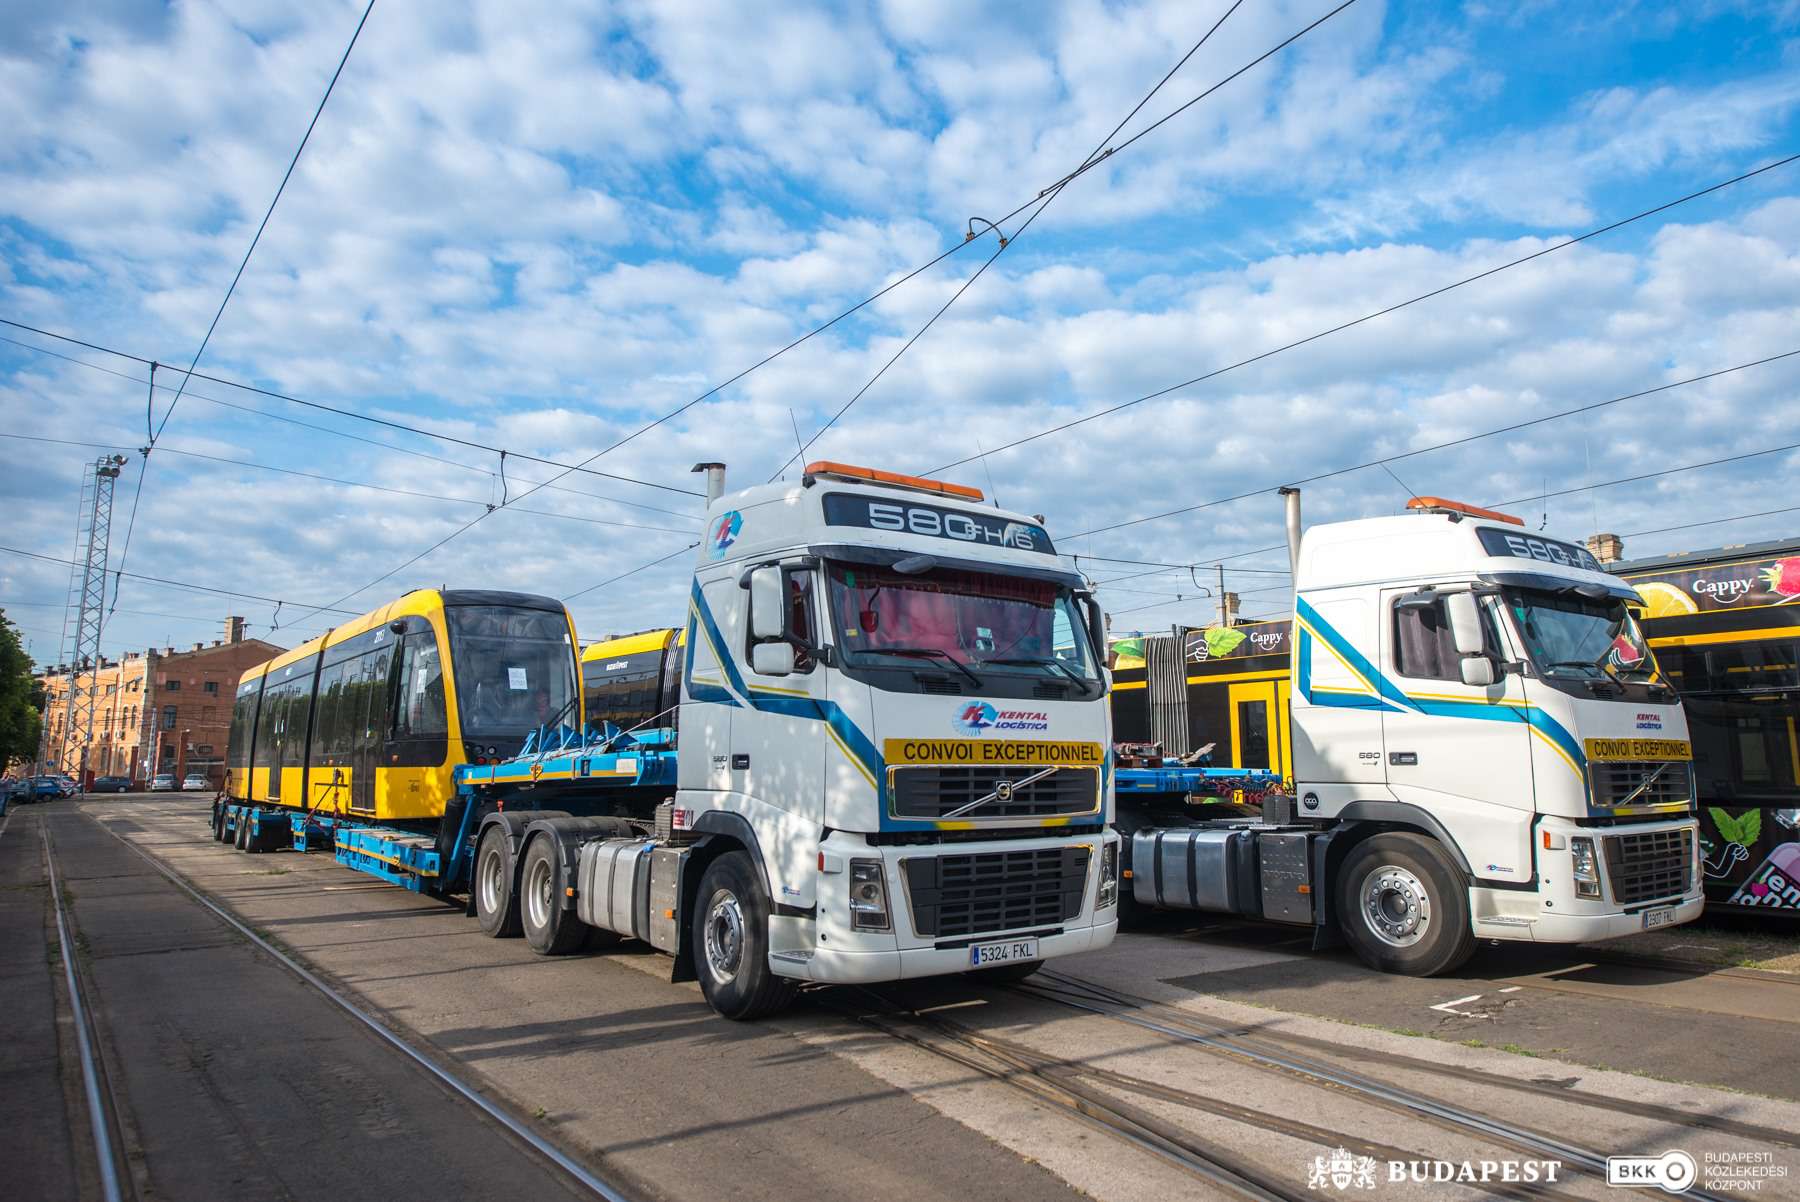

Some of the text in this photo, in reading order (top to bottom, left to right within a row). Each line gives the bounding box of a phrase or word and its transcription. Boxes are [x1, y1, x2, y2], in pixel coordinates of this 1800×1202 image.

[868, 503, 977, 541] 580
[1504, 535, 1569, 566] 580
[1692, 579, 1752, 596] Cappy
[1250, 632, 1283, 645] Cappy
[998, 711, 1048, 721] KENTAL
[1636, 713, 1661, 722] KENTAL
[995, 721, 1048, 730] LOGÍSTICA
[903, 743, 1098, 761] CONVOI EXCEPTIONNEL
[1594, 742, 1689, 757] CONVOI EXCEPTIONNEL
[981, 943, 1033, 962] 5324 FKL
